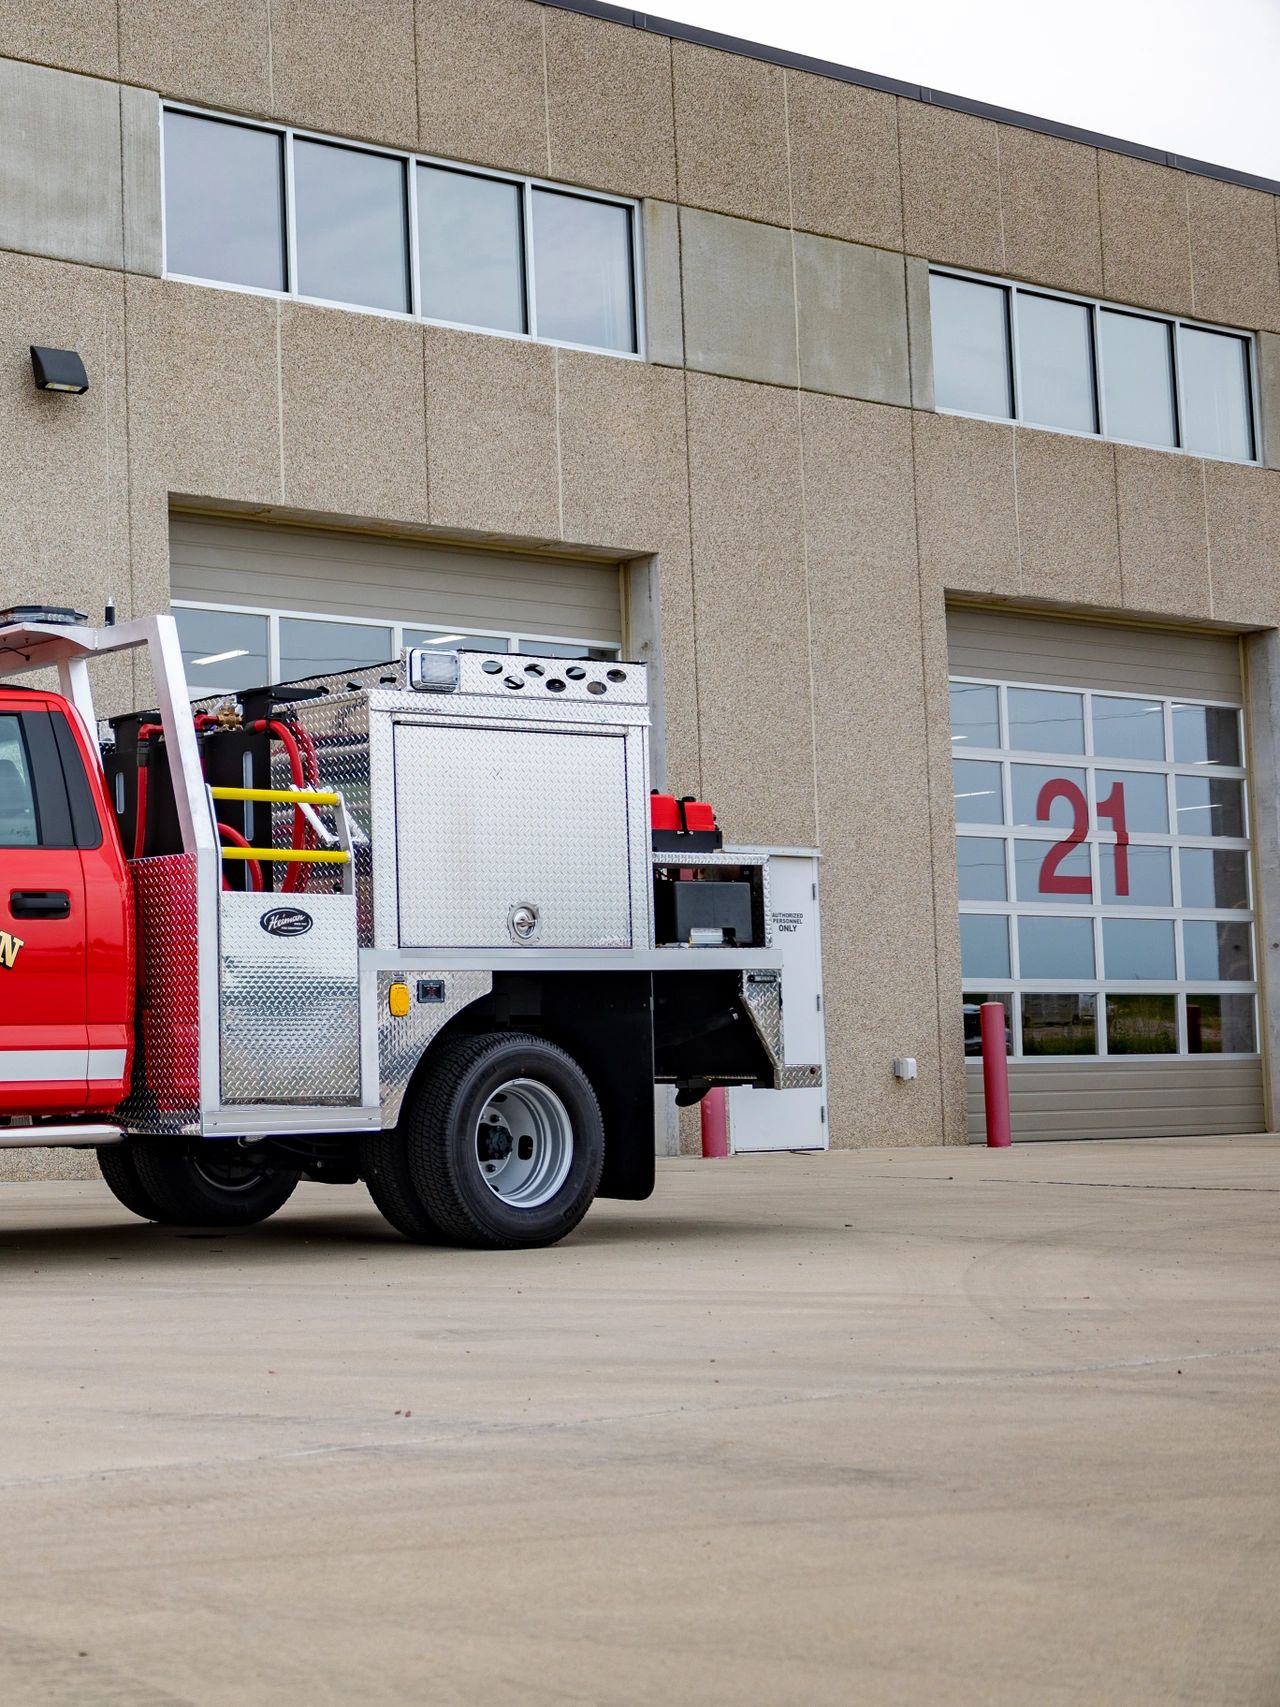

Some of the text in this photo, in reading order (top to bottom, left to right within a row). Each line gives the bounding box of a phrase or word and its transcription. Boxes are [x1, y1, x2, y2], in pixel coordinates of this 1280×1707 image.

[1036, 778, 1129, 896] 21
[268, 913, 306, 931] Heiman
[778, 924, 797, 932] ONLY
